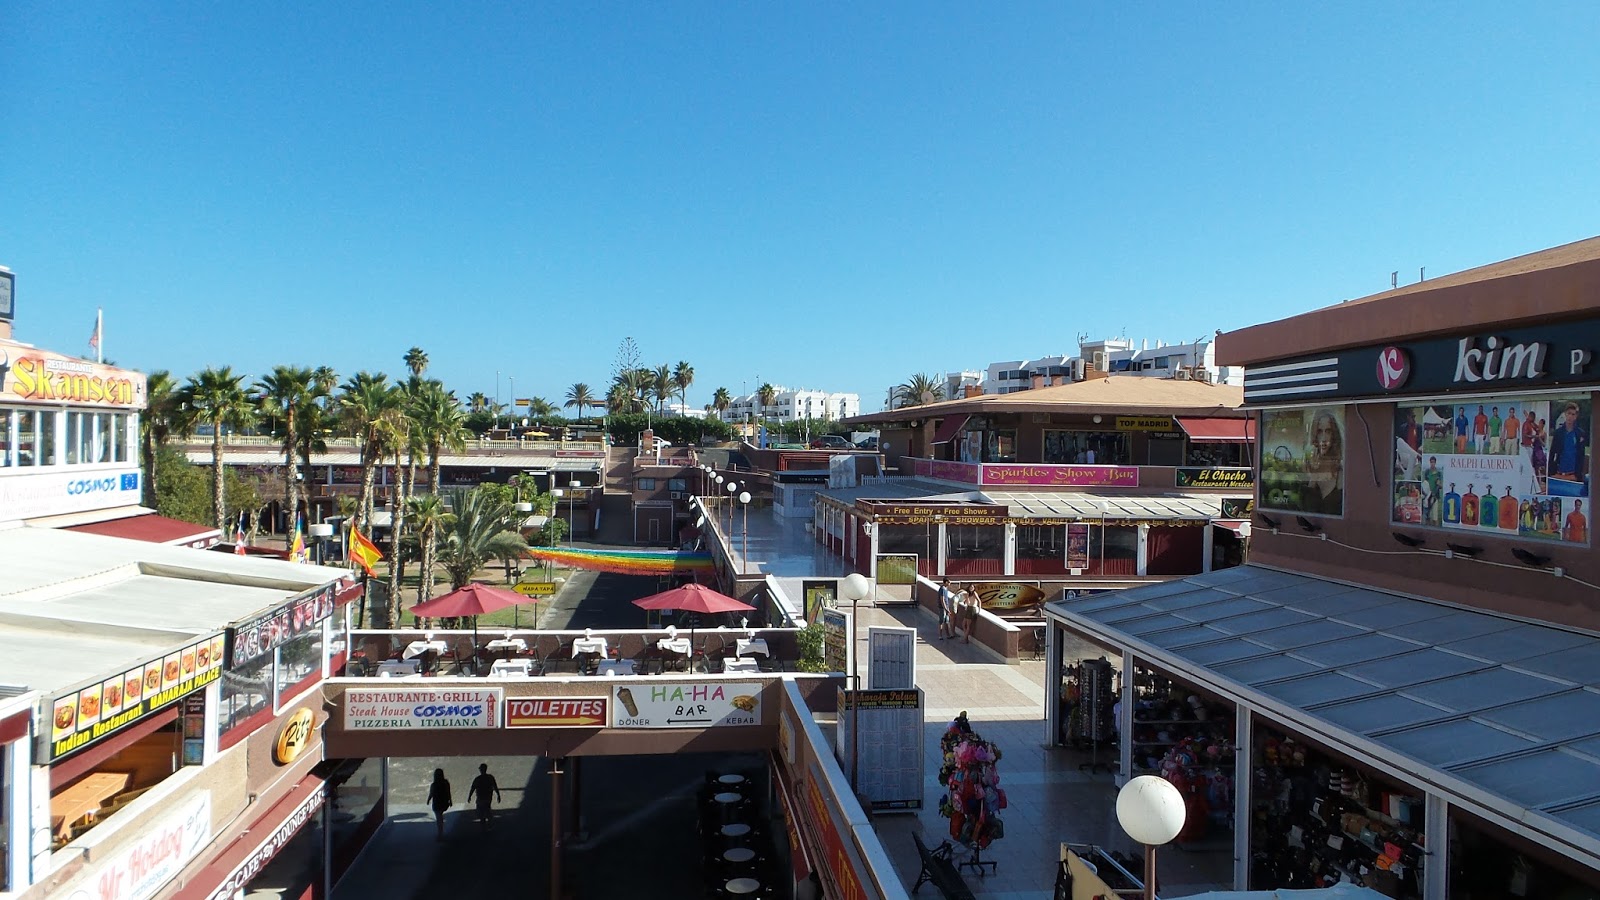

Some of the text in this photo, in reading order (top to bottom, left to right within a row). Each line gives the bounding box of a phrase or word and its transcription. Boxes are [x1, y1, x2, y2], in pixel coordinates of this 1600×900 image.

[1454, 336, 1542, 382] kim
[47, 360, 93, 373] RESTAURANTE
[12, 356, 132, 404] Skansen
[1450, 457, 1514, 470] RALPH LAUREN
[987, 466, 1048, 480] Sparkles
[1054, 467, 1096, 480] Show
[1103, 467, 1134, 480] Bar
[1199, 470, 1246, 480] El Chacho
[67, 477, 116, 495] COSMOS
[894, 507, 988, 515] Free Entry Free Shows
[980, 589, 1017, 603] Gio
[349, 693, 436, 703] RESTAURANTE
[442, 692, 483, 702] GRILL
[651, 685, 725, 702] HA-HA
[55, 667, 220, 757] Indian Restaurant MAHARAJA PALACE
[349, 704, 483, 718] Steak House COSMOS
[511, 701, 603, 716] TOILETTES
[675, 705, 707, 717] BAR
[354, 718, 478, 728] PIZZERIA ITALIANA
[618, 717, 650, 726] DÖNER
[234, 853, 260, 888] CAFE
[276, 808, 307, 848] LOUNGE
